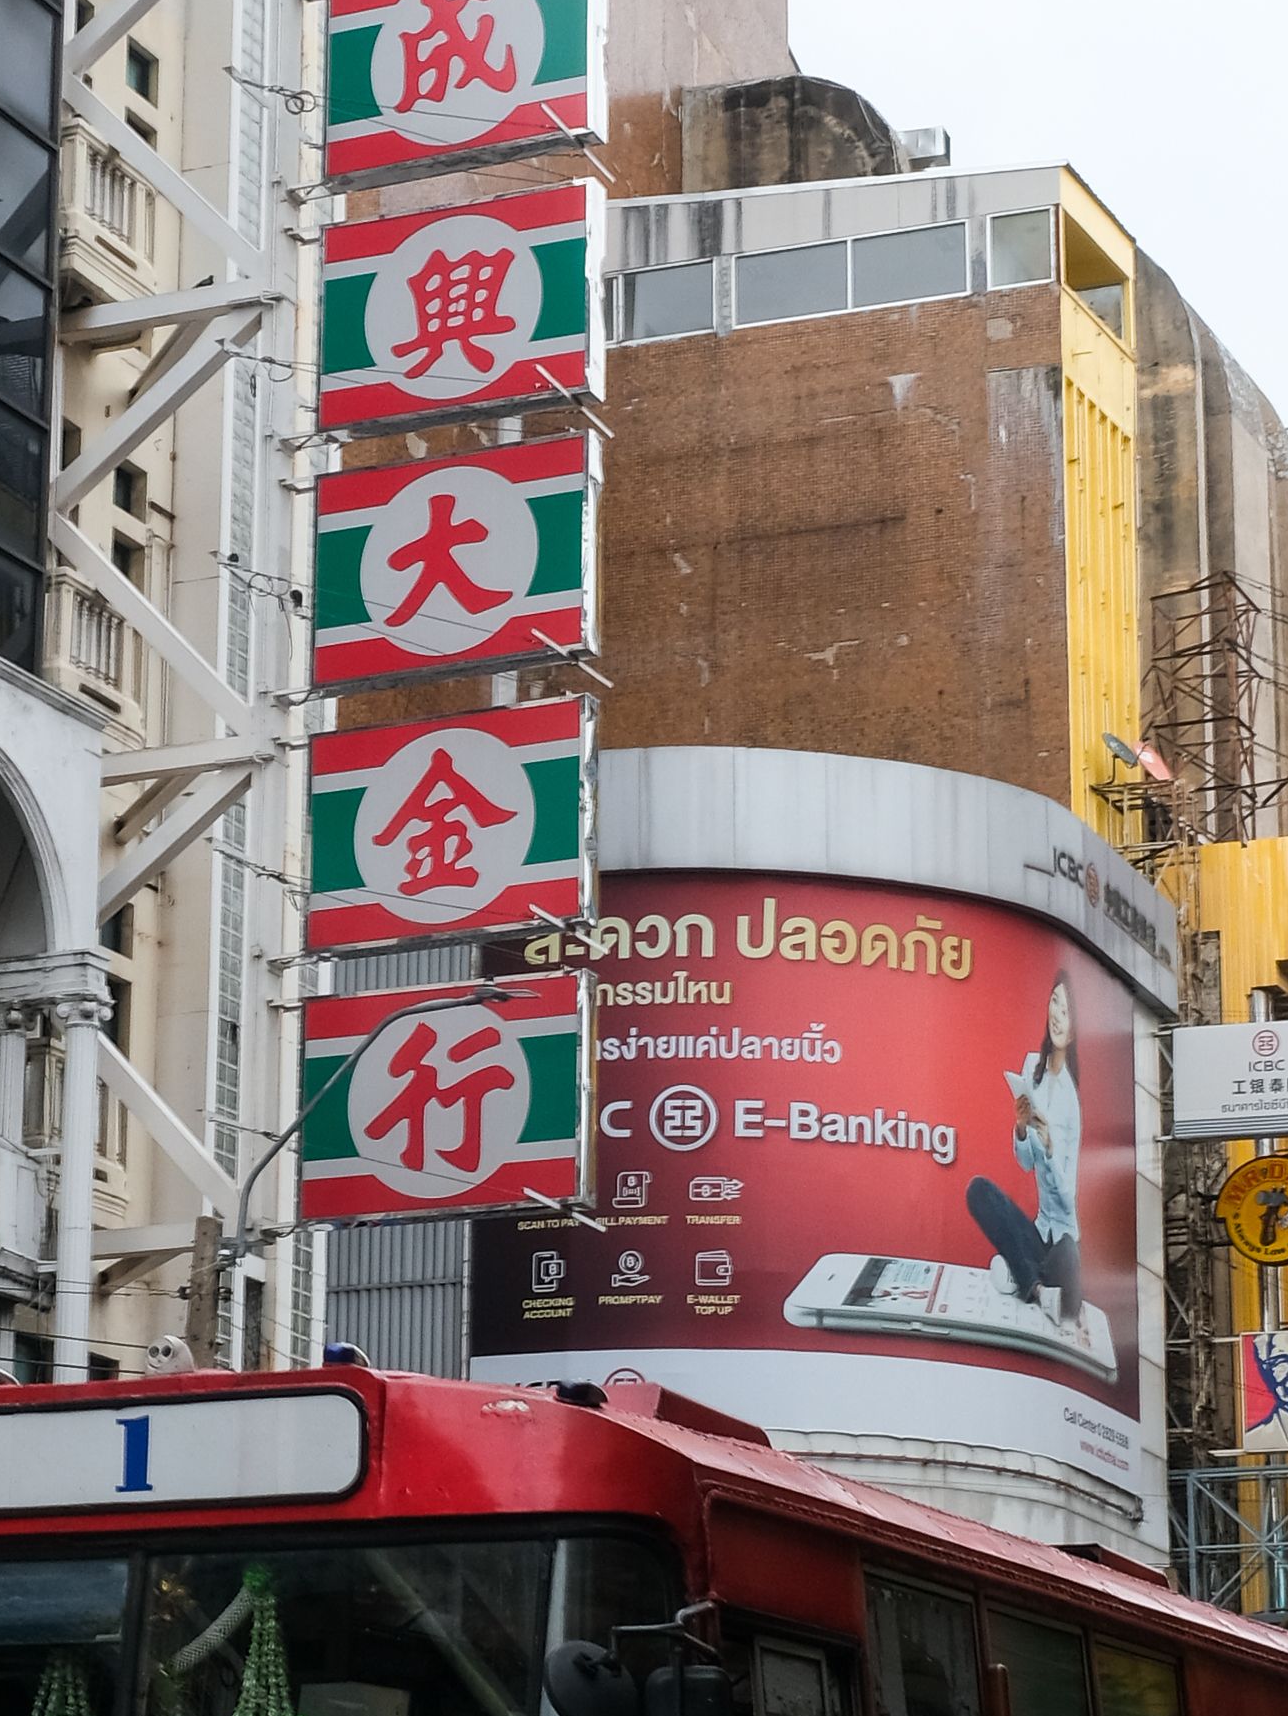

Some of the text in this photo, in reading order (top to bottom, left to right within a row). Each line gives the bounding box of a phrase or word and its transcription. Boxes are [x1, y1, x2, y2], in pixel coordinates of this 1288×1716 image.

[1052, 845, 1085, 889] ICBC
[736, 898, 972, 981] ปลอดภัย
[1249, 1059, 1286, 1072] ICBC
[734, 1100, 957, 1165] E-Banking
[517, 1220, 546, 1232] SCAN
[547, 1219, 560, 1230] TO
[619, 1214, 670, 1226] PAYMENT
[685, 1214, 743, 1225] TRANSFER
[521, 1296, 576, 1309] CHECKING
[598, 1293, 663, 1306] PROMPTPAY
[686, 1293, 742, 1305] E-WALLET
[522, 1307, 573, 1321] ACCOUNT
[694, 1305, 734, 1316] TOP UP
[114, 1415, 154, 1493] 1
